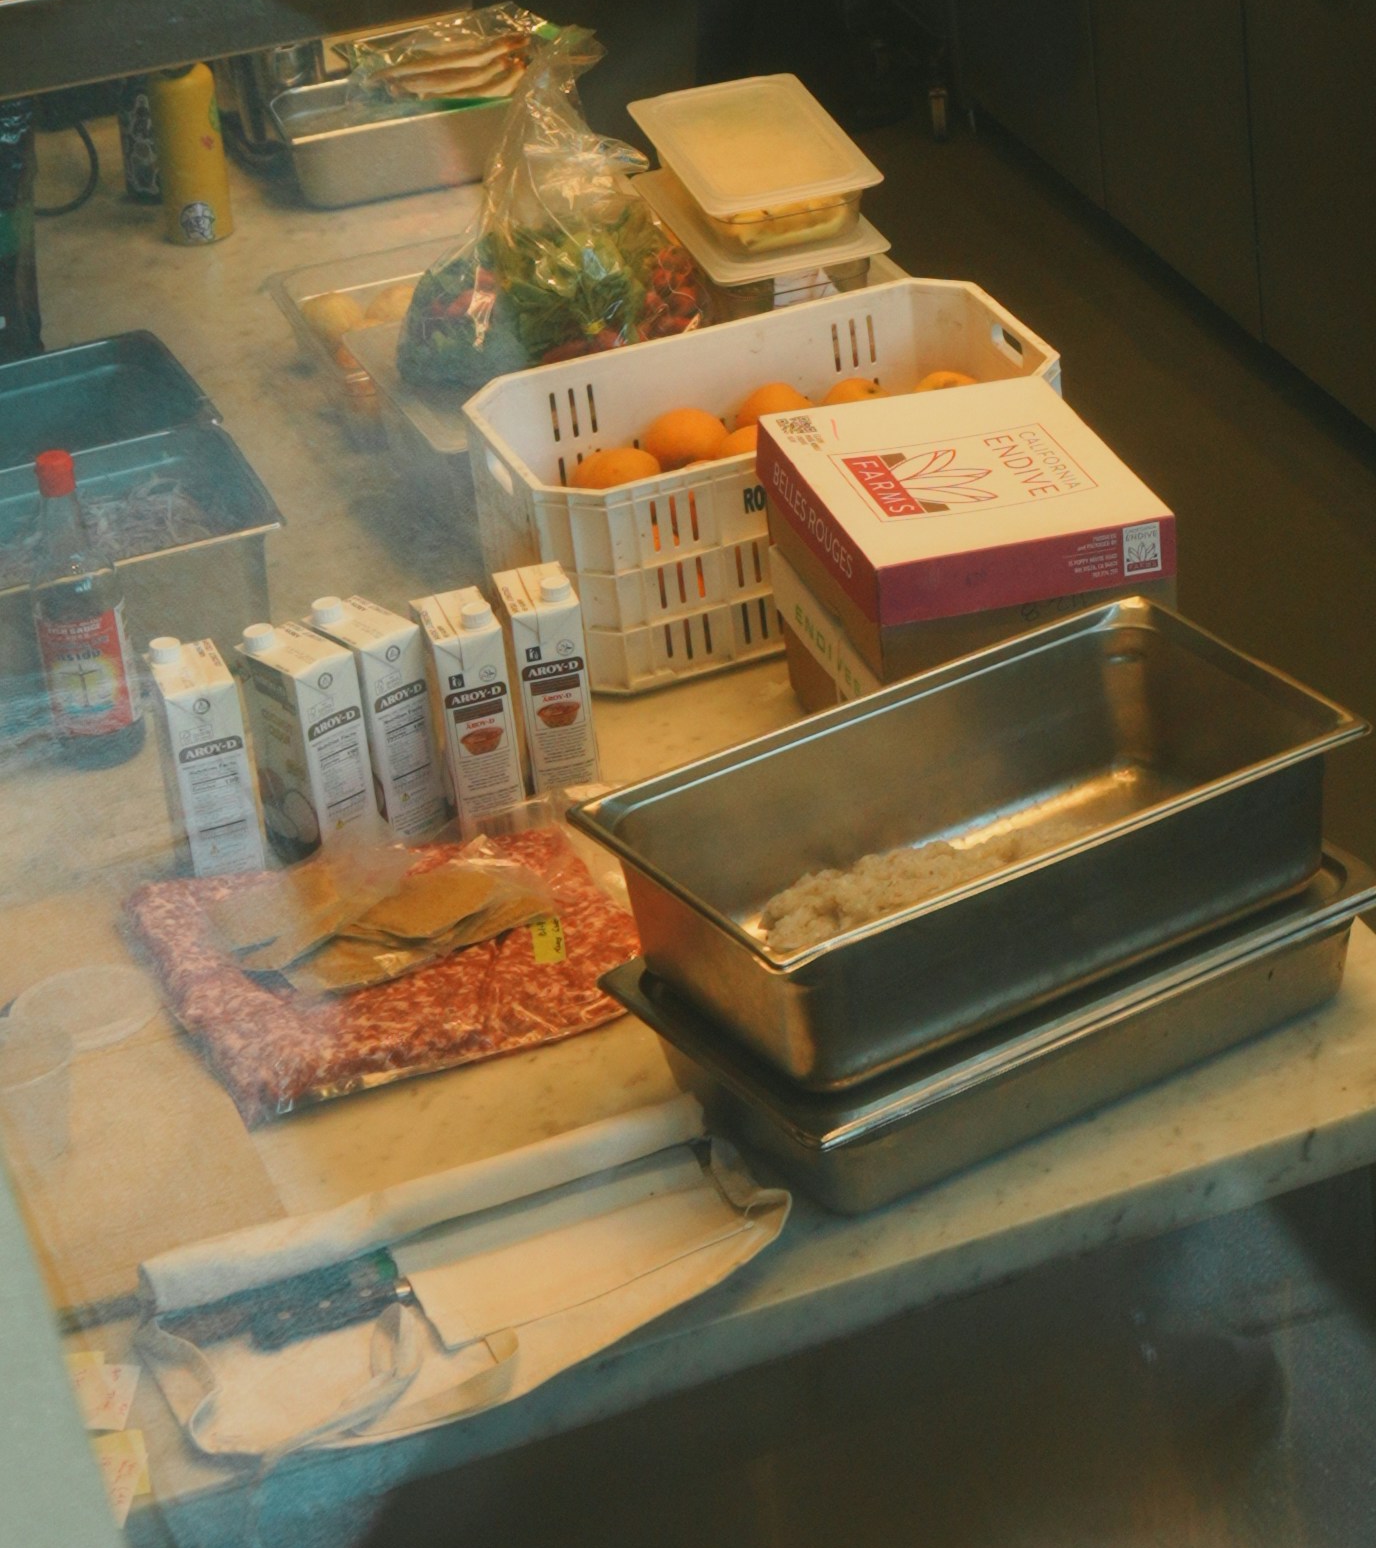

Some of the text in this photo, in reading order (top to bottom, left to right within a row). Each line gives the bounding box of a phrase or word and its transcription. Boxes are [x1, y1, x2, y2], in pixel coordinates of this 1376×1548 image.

[984, 434, 1059, 498] ENDIVE
[1018, 430, 1082, 490] CALIFORNIA
[851, 459, 917, 515] FARMS
[772, 462, 807, 522] BELLES
[808, 507, 854, 580] ROUGES
[1125, 529, 1157, 542] ENDIVE
[526, 658, 580, 678] AROY-D
[379, 683, 424, 710] AROY-D
[450, 685, 503, 706] AROY-D
[541, 690, 573, 704] AROY-D
[312, 709, 358, 737] AROY-D
[465, 718, 496, 731] AROY-D
[185, 739, 238, 761] AROY-D
